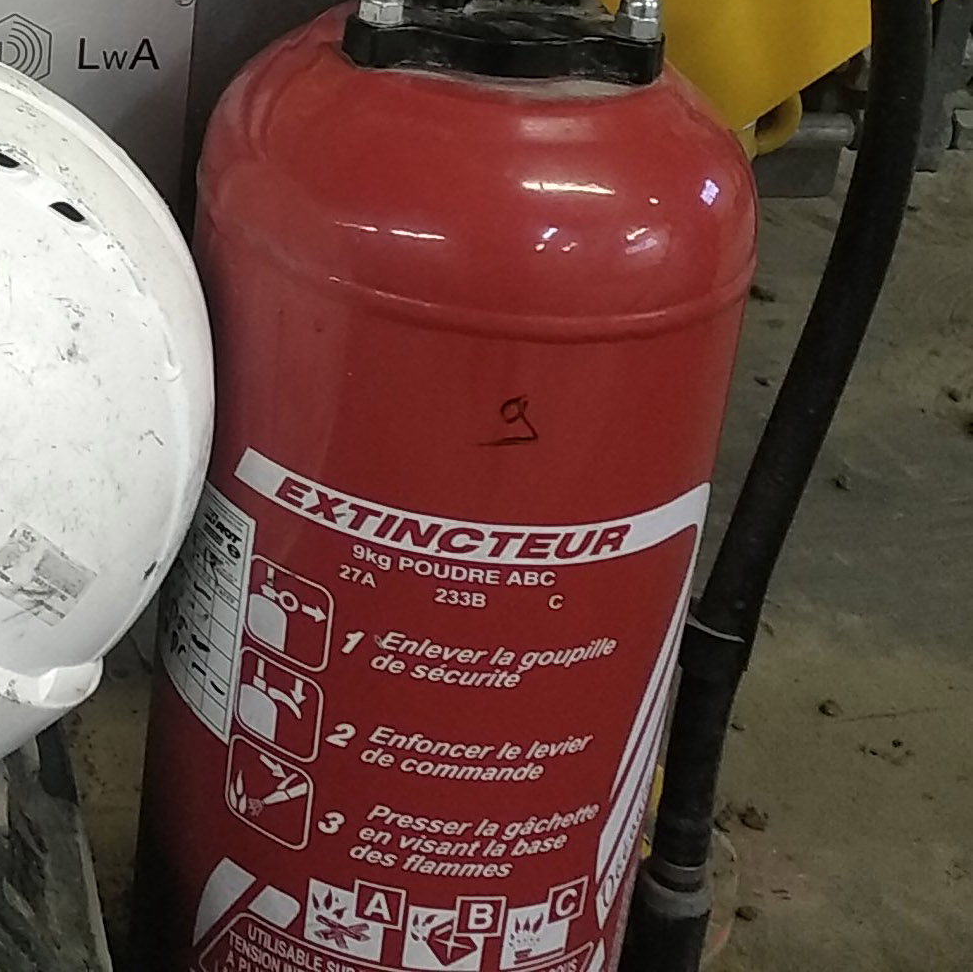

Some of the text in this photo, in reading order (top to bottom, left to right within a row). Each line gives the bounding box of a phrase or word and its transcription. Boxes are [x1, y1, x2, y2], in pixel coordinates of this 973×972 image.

[274, 476, 632, 560] EXTINCTEUR
[339, 563, 377, 589] 27A
[352, 544, 557, 587] 9kg POUDRE ABC
[434, 587, 565, 610] 233B C
[341, 630, 618, 674] 1 Enlever la goupille
[370, 654, 522, 688] de sécurité
[324, 722, 595, 761] 2 Enfoncer le levier
[360, 747, 545, 782] de commande
[317, 803, 601, 841] 3 Presser la gâchette
[349, 844, 514, 878] des flammes
[358, 827, 568, 857] en visant la base
[364, 888, 578, 930] A B C
[228, 929, 281, 972] TENSION
[247, 923, 324, 972] UTILISABLE
